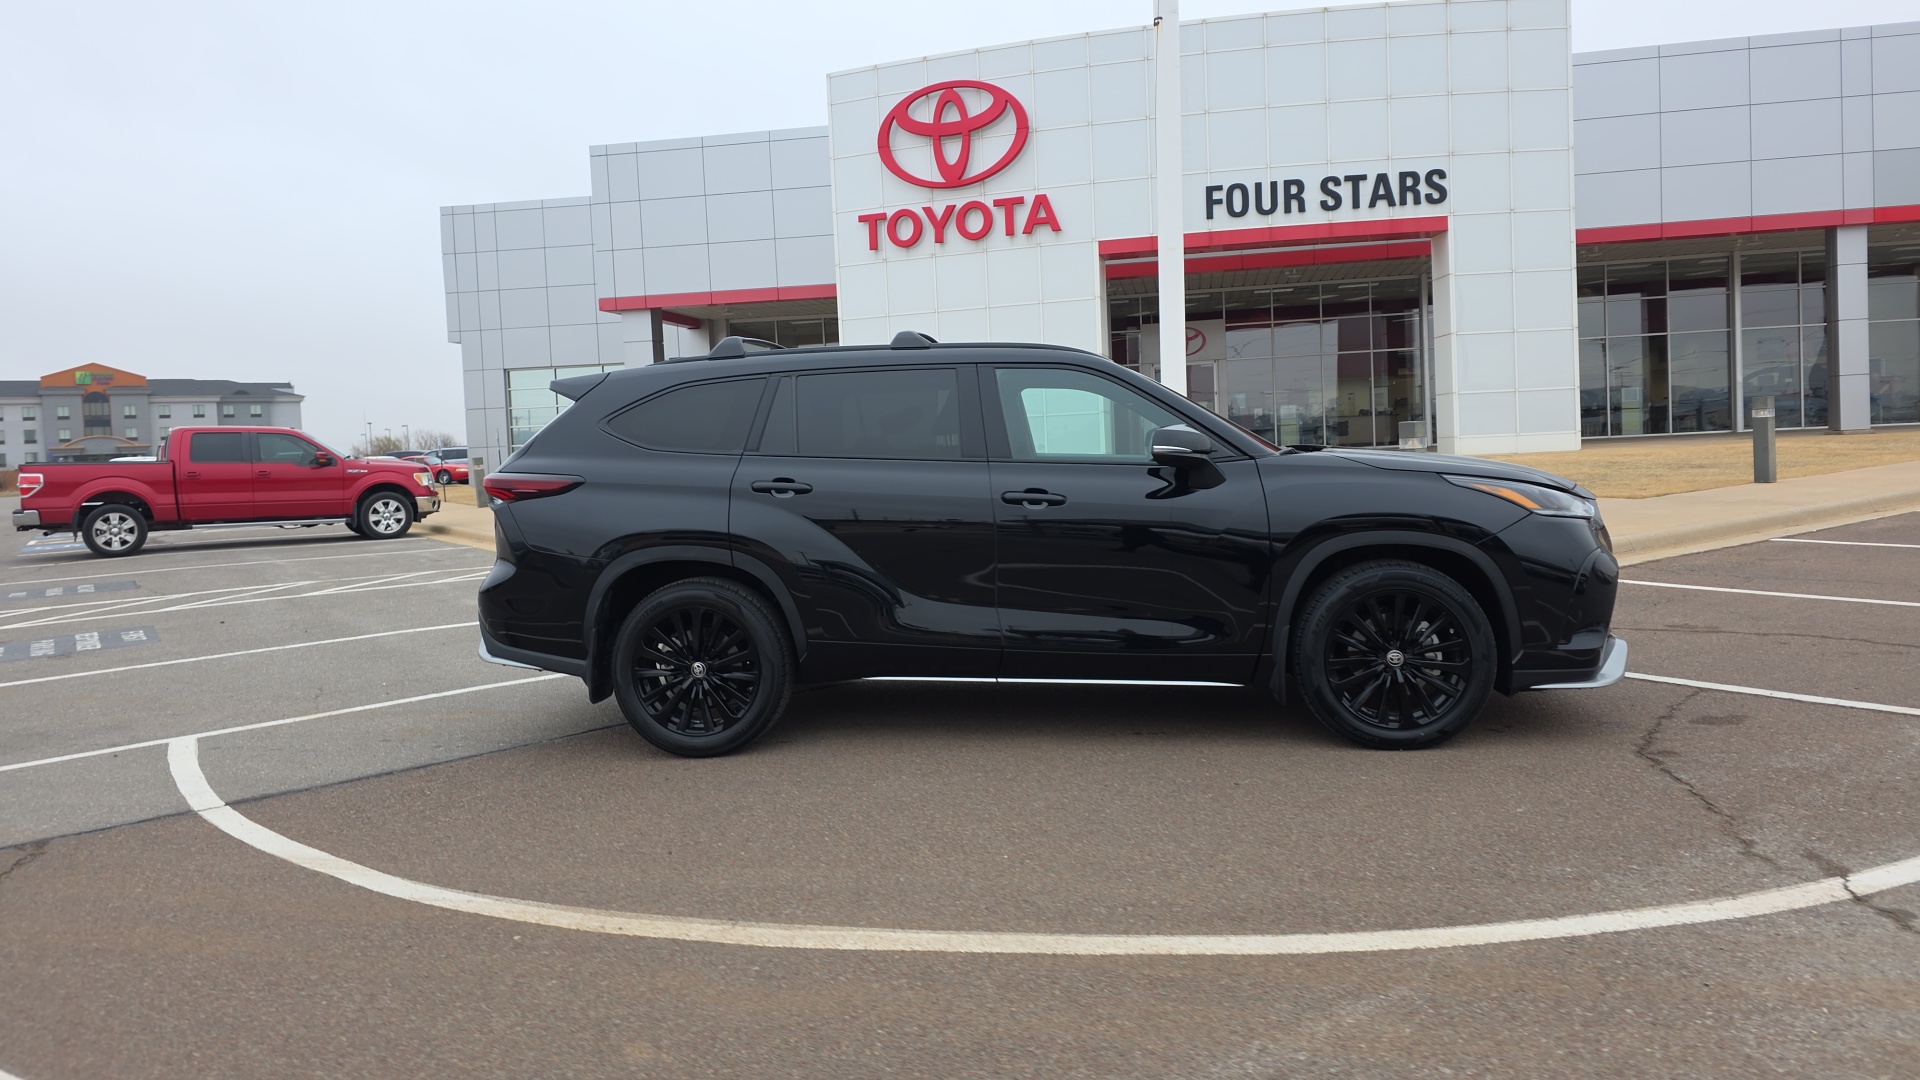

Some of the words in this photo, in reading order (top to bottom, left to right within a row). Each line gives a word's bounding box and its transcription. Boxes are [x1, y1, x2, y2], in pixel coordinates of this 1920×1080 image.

[1205, 178, 1306, 219] FOUR
[1319, 168, 1448, 212] STARS
[858, 194, 1062, 251] TOYOTA
